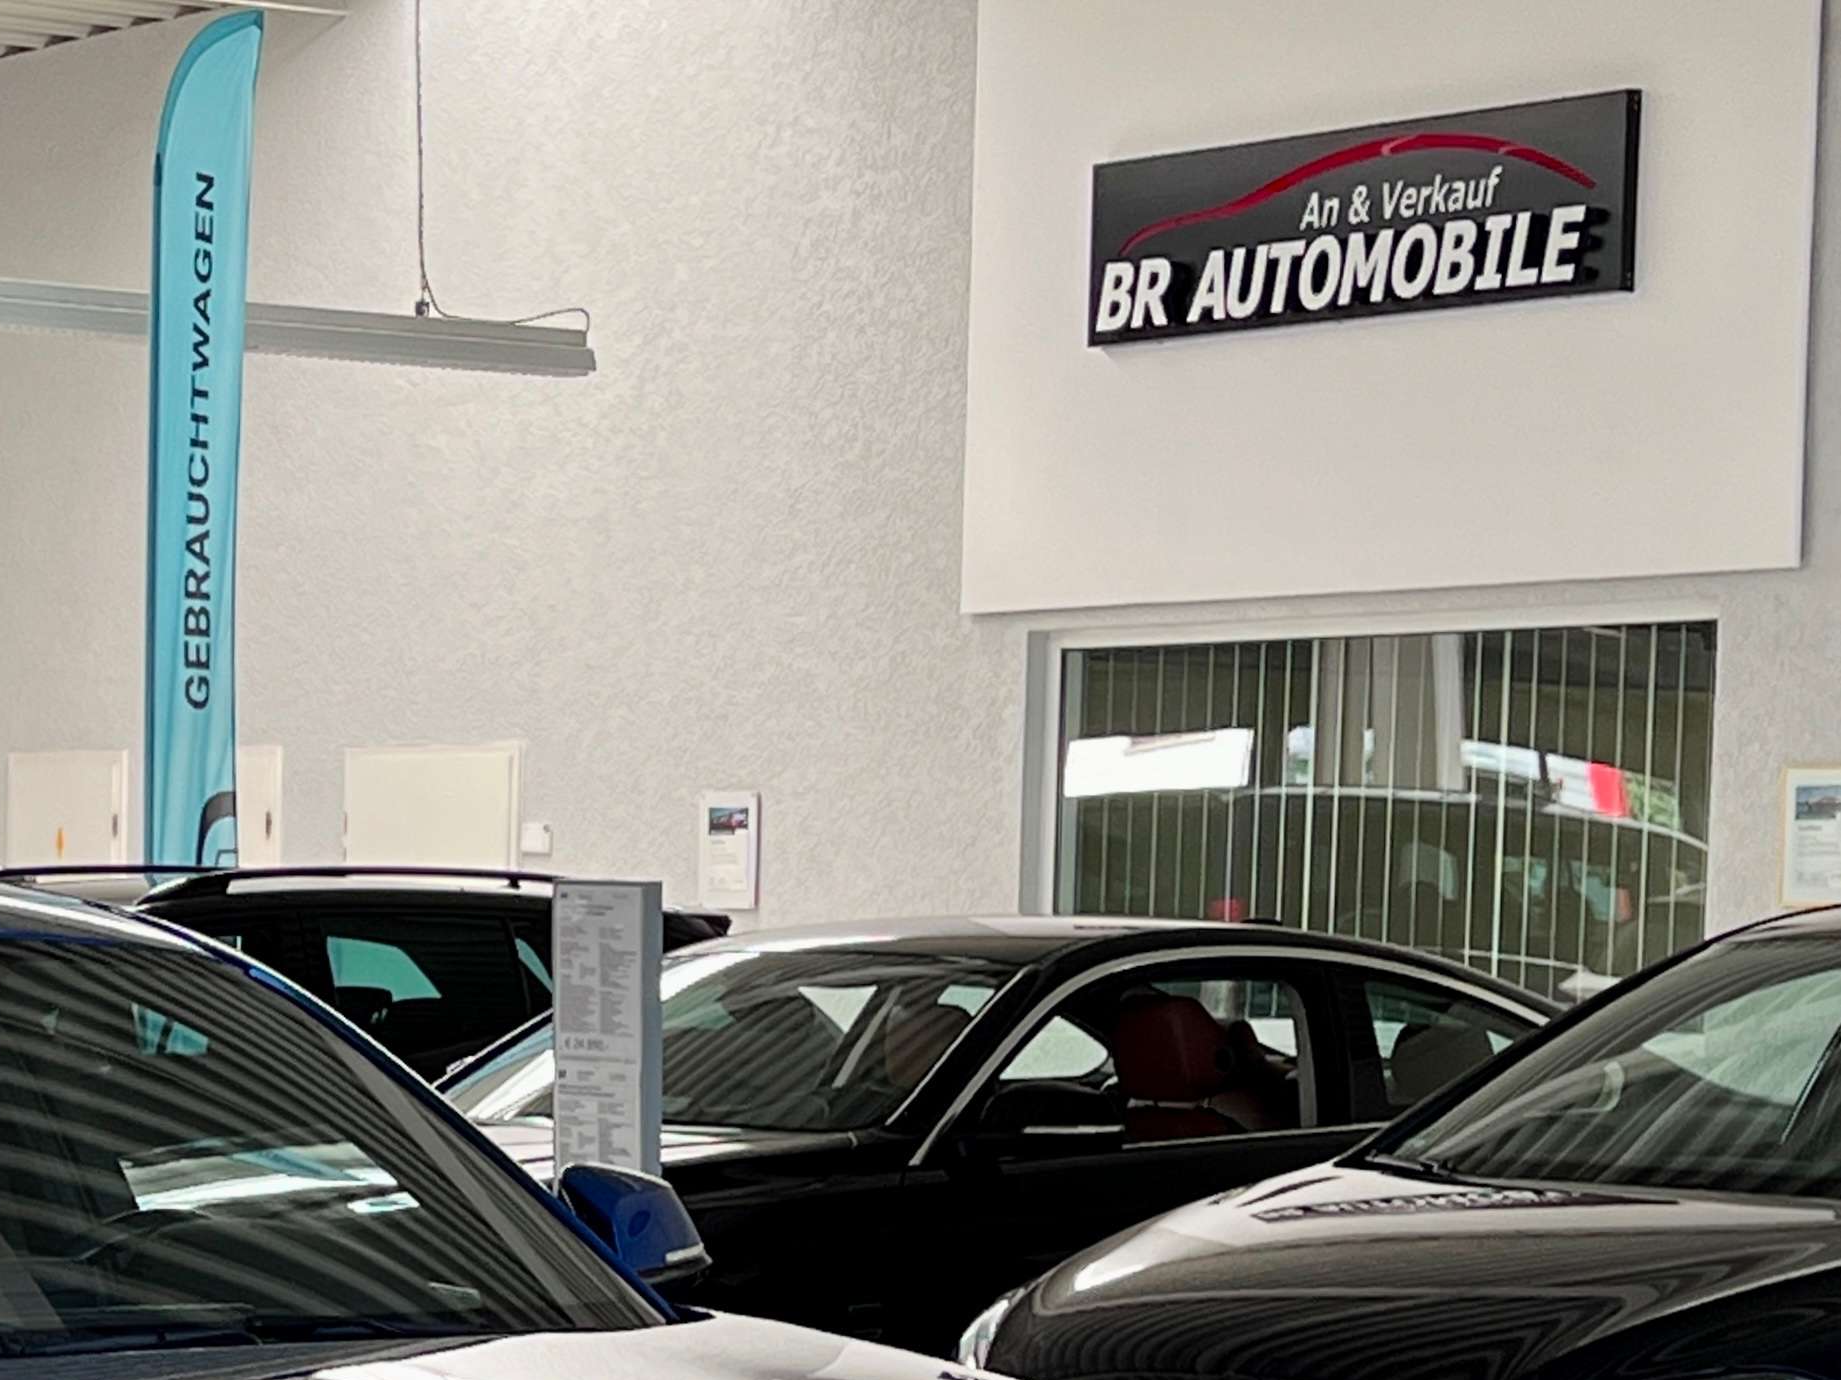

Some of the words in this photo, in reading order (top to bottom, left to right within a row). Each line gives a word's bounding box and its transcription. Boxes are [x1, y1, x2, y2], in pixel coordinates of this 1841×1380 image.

[1300, 191, 1337, 231] An
[1348, 185, 1371, 224] &
[1381, 165, 1503, 217] Verkauf
[1094, 257, 1172, 333] BR
[1186, 204, 1587, 324] AUTOMOBILE
[184, 171, 215, 711] GEBRAUCHTWAGEN
